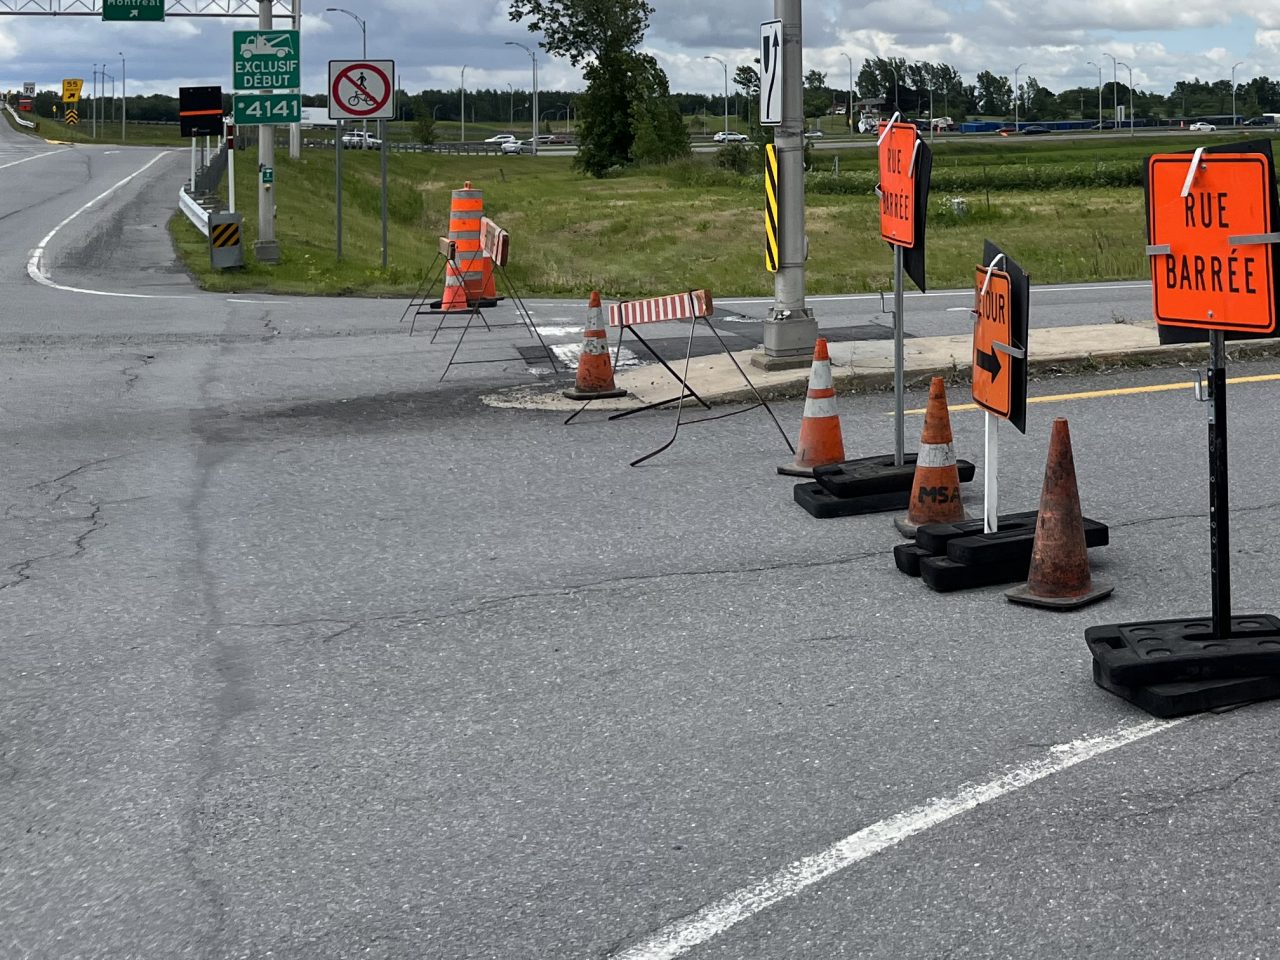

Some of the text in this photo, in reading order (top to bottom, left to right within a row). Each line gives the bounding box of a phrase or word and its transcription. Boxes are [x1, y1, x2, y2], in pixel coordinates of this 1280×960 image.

[235, 60, 298, 73] EXCLUSIF
[243, 73, 291, 87] DÉBUT
[25, 86, 34, 94] 70
[887, 148, 902, 175] RUE
[1184, 192, 1230, 229] RUE
[1165, 248, 1257, 294] BARRÉE
[979, 286, 1006, 325] TOUR
